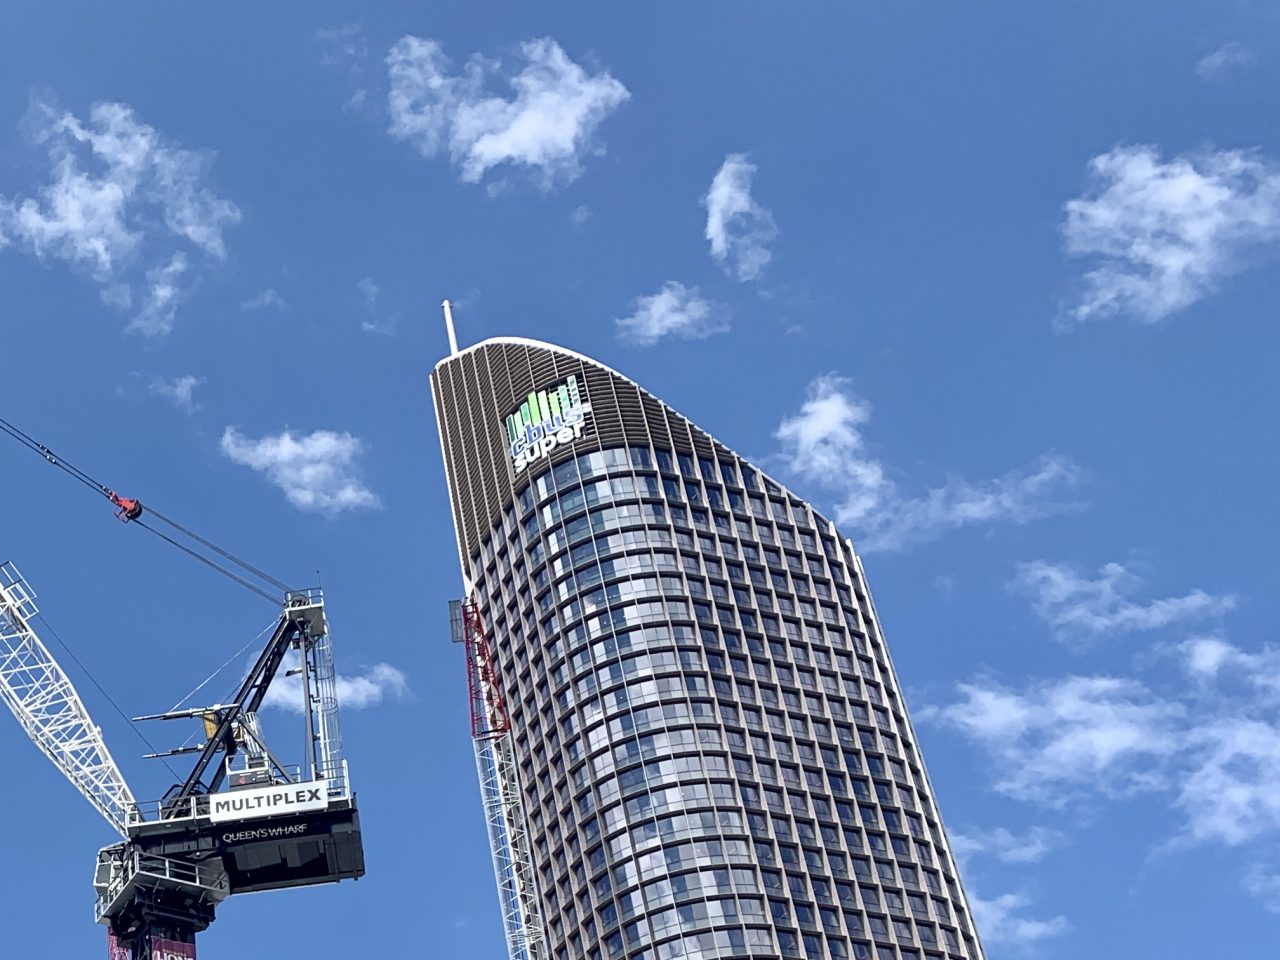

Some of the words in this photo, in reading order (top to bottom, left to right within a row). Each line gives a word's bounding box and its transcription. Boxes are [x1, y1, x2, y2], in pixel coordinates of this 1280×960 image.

[514, 421, 585, 473] super
[215, 788, 321, 813] MULTIPLEX
[222, 829, 268, 843] QUEEN'S
[268, 824, 308, 837] WHARF
